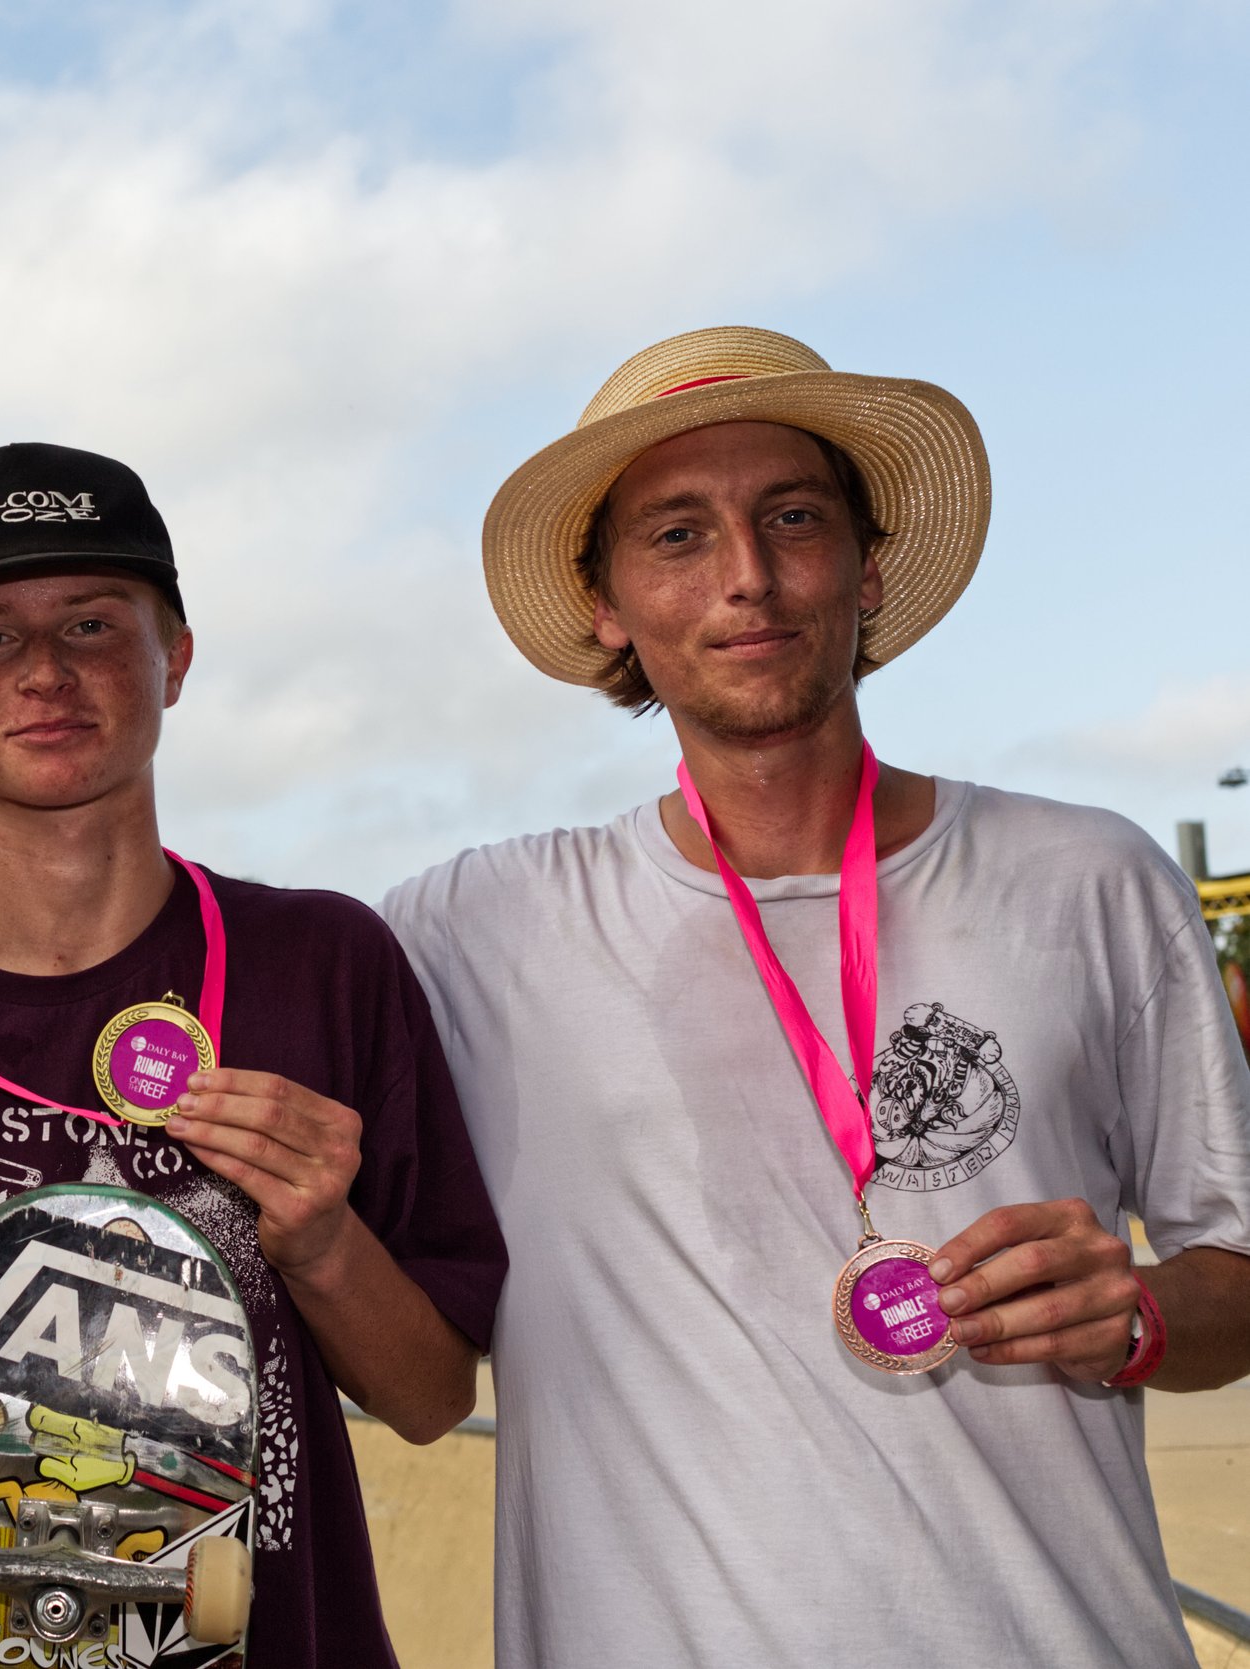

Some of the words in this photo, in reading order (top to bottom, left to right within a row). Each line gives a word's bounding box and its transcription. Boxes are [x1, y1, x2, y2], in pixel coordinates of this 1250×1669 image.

[147, 1043, 171, 1057] DALY
[171, 1051, 189, 1063] BAY
[133, 1054, 176, 1083] RUMBLE
[129, 1075, 141, 1086] ON
[138, 1079, 169, 1100] REEF
[2, 1107, 149, 1148] STONE
[132, 1146, 192, 1180] CO.
[880, 1285, 905, 1302] DALY
[906, 1277, 926, 1291] BAY
[880, 1295, 928, 1328] RUMBLE
[890, 1330, 905, 1341] ON
[903, 1318, 935, 1343] REEF
